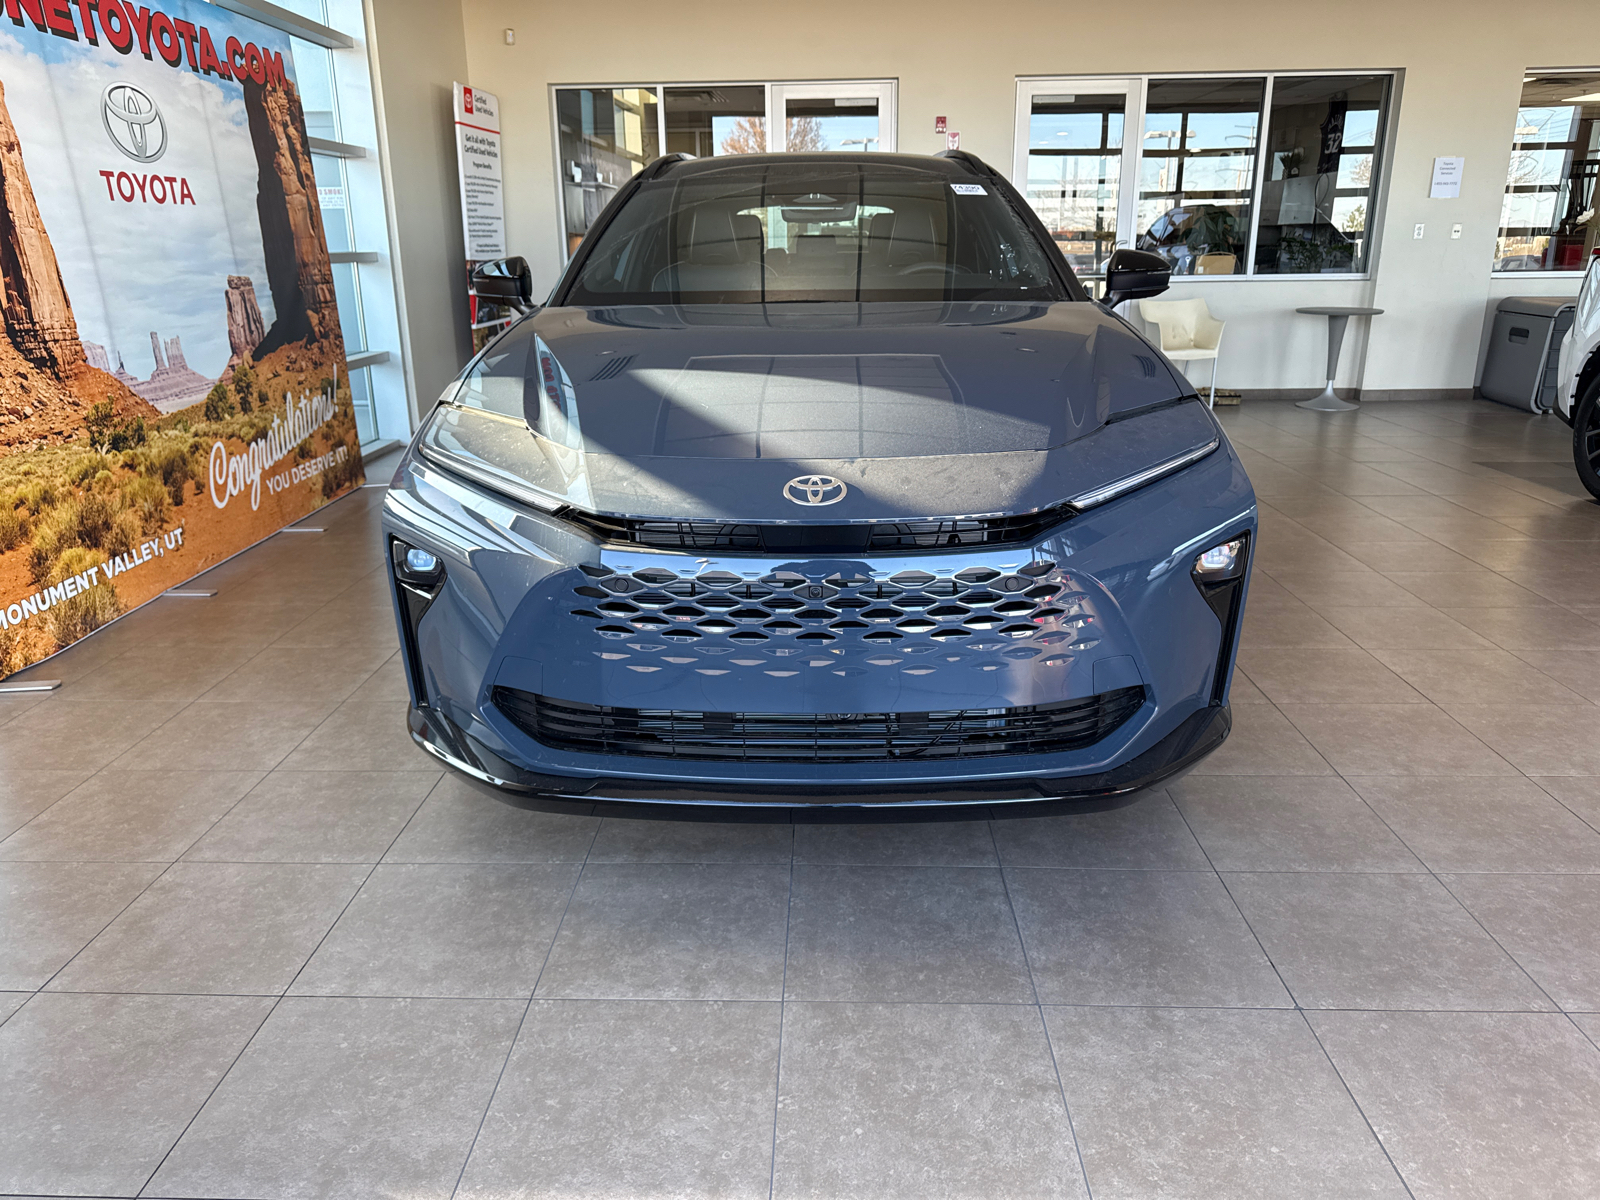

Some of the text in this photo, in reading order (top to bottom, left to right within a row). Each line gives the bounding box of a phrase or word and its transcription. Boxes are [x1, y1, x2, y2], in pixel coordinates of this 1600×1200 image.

[1324, 133, 1341, 154] 32
[99, 170, 196, 205] TOYOTA
[209, 363, 339, 511] Congratulations!
[266, 446, 349, 495] YOU DESERVE IT!
[102, 538, 164, 580] VALLEY,
[164, 527, 184, 550] UT
